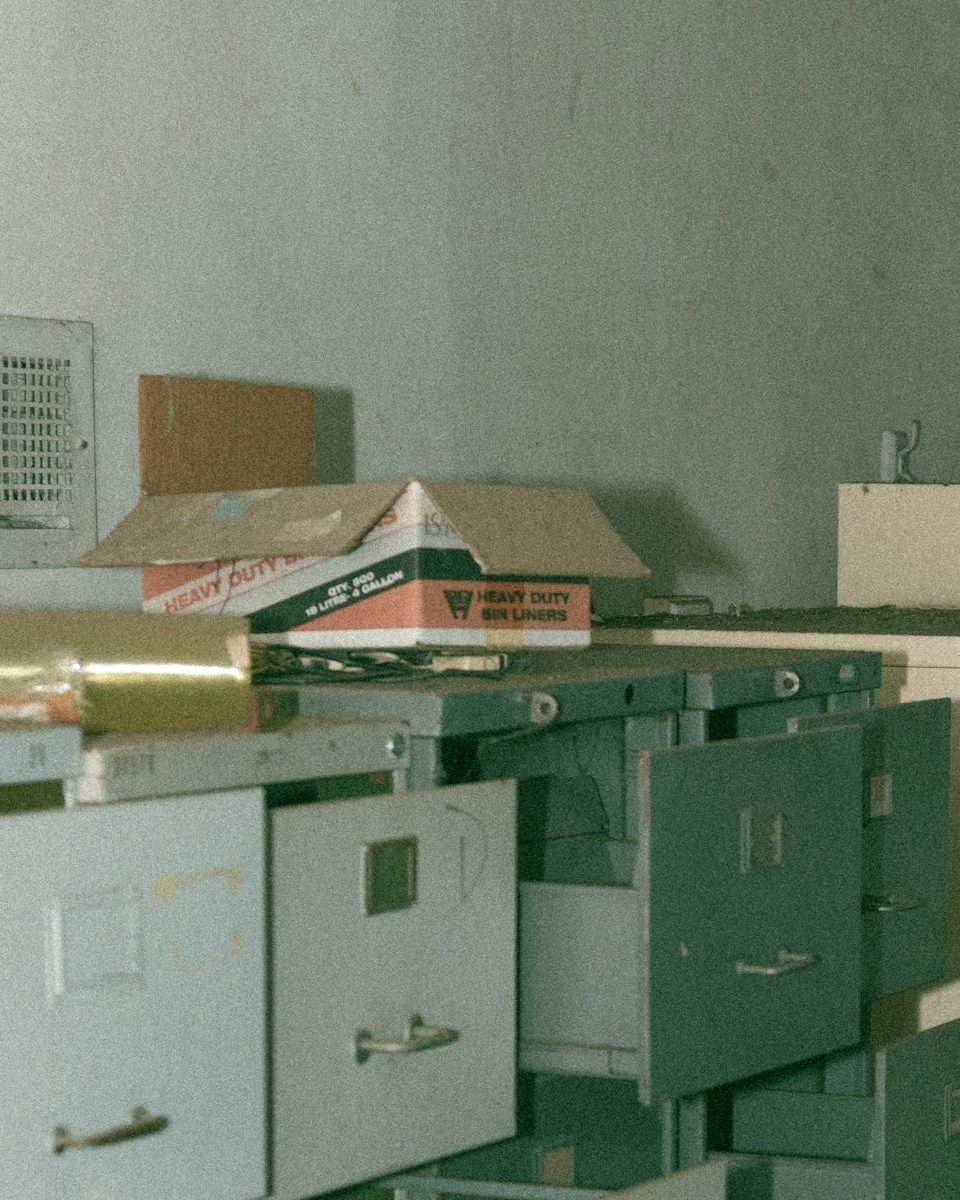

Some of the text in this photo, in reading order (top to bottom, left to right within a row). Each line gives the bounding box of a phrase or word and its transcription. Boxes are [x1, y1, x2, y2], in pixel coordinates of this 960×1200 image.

[164, 557, 278, 614] HEAVY DUTY
[361, 570, 404, 594] GALLON
[478, 590, 570, 605] HEAVY DUTY
[481, 607, 568, 622] BIN LINERS
